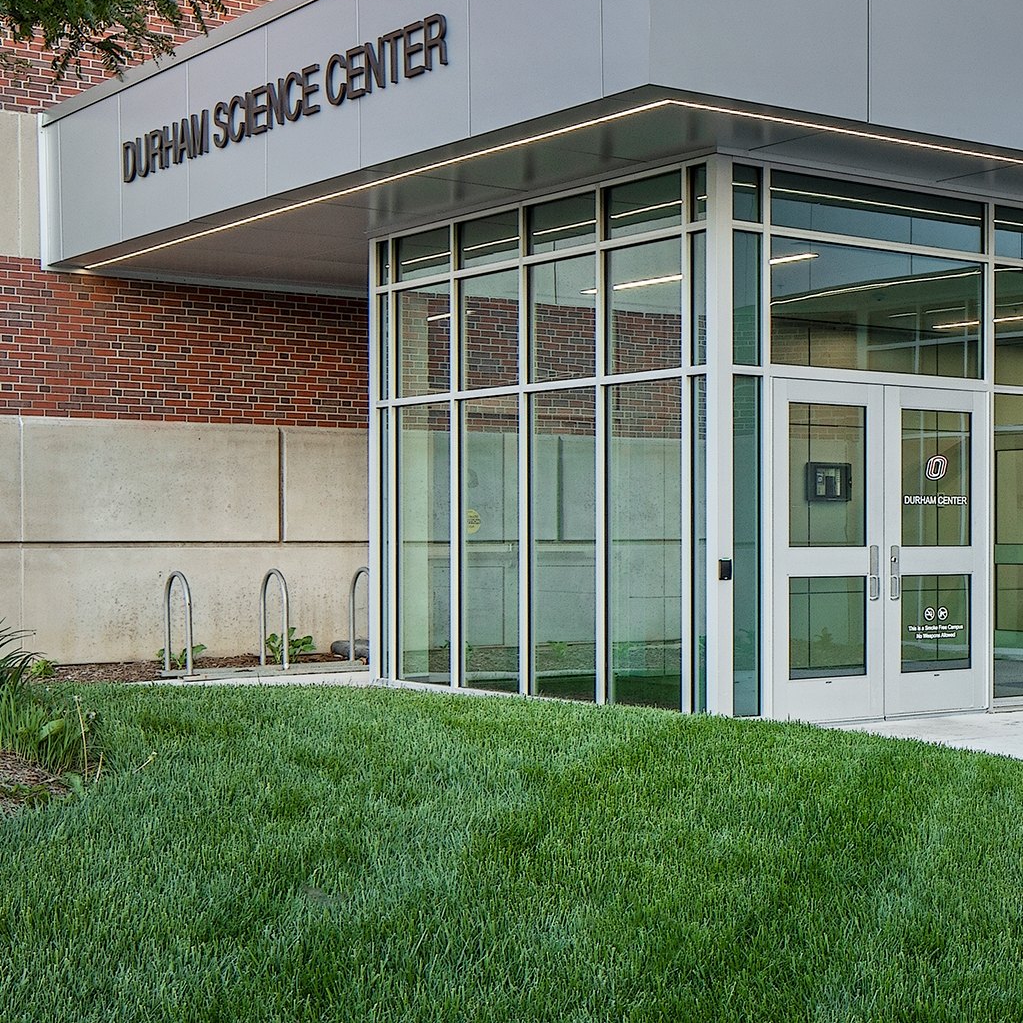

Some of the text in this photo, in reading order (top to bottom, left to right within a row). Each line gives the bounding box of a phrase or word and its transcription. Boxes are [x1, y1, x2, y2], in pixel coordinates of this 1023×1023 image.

[123, 14, 448, 183] DURHAM SCIENCE CENTER
[904, 495, 967, 505] DURHAM CENTER
